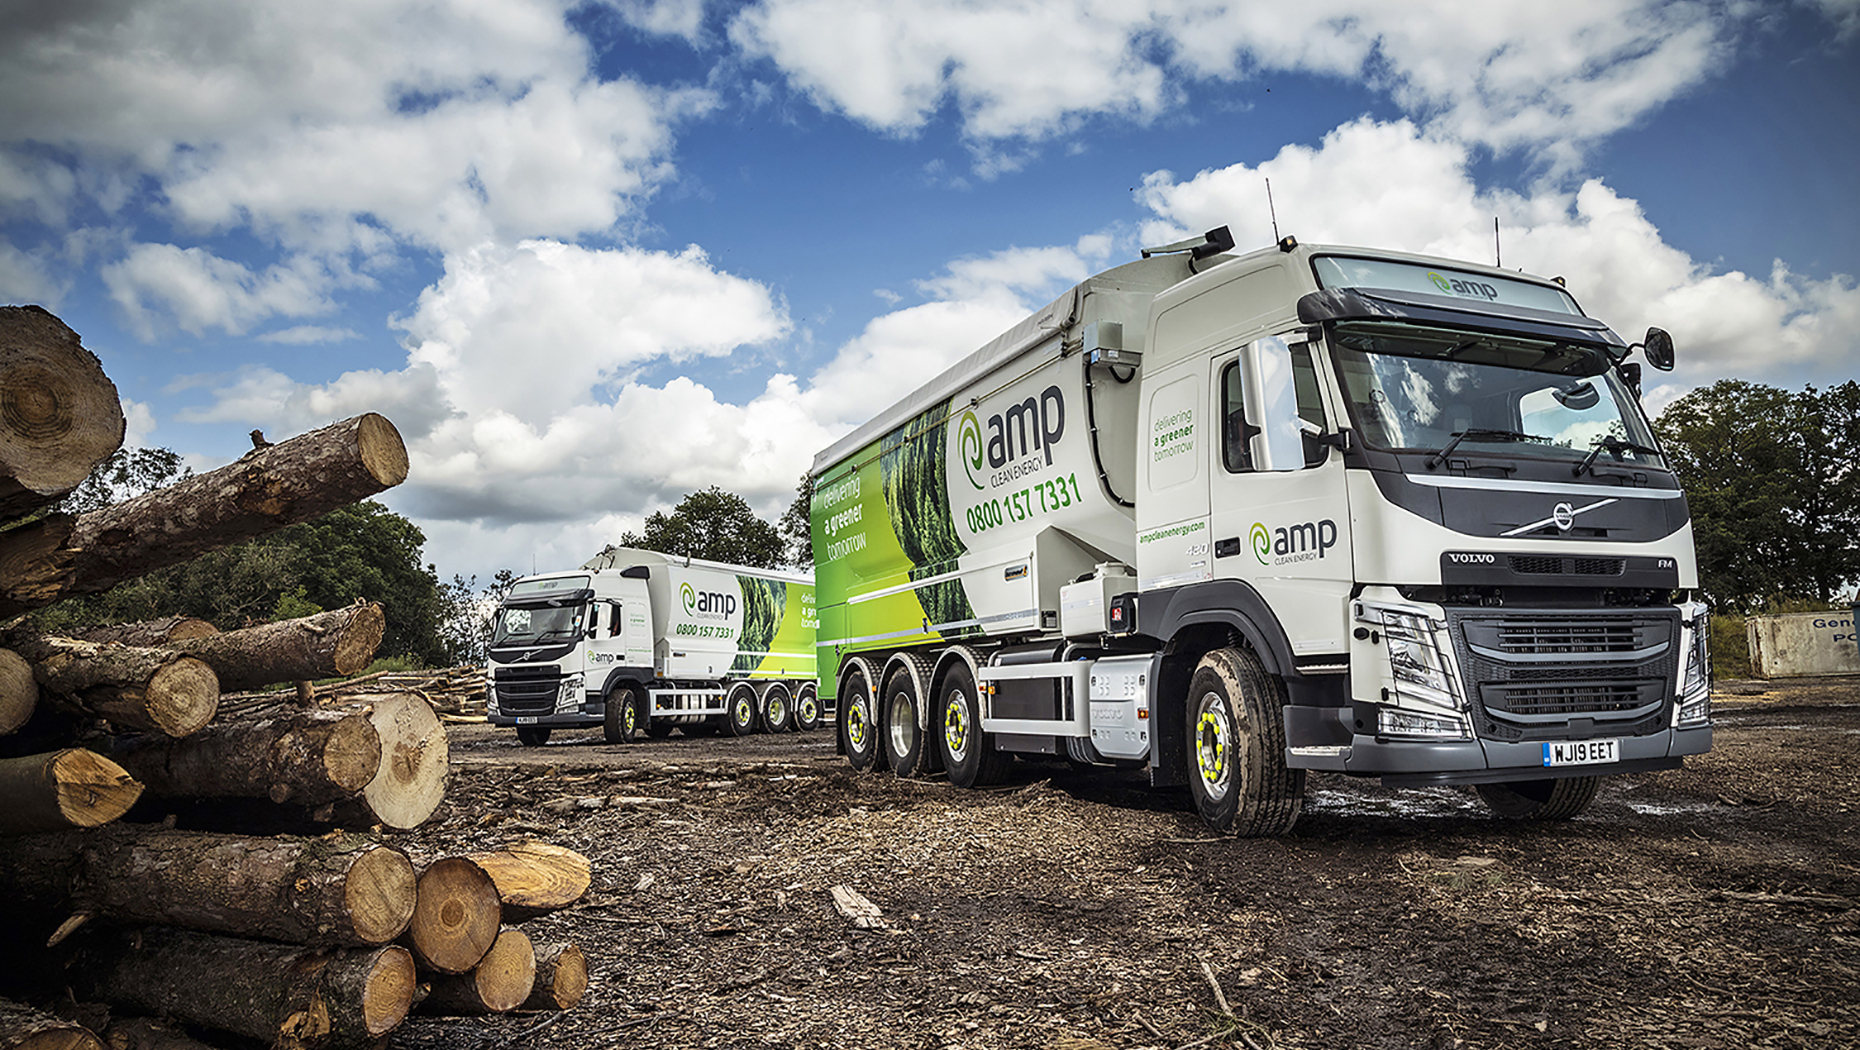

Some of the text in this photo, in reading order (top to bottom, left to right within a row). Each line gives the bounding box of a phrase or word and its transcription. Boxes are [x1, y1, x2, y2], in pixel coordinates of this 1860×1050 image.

[1450, 279, 1498, 301] amp
[987, 385, 1065, 469] amp
[1154, 410, 1192, 432] delivering
[1154, 424, 1194, 447] a greener
[1154, 441, 1194, 462] tomorrow
[990, 456, 1043, 488] CLEAN ENERGY
[824, 476, 860, 509] delivering
[966, 472, 1082, 534] 0800 157 7331
[824, 503, 862, 537] a greener
[1140, 522, 1205, 544] ampcleanenergy.com
[1274, 519, 1337, 559] amp
[827, 532, 867, 561] tomorrow
[1186, 543, 1209, 556] 420
[1274, 552, 1317, 566] CLEAN ENERGY
[1448, 553, 1495, 563] VOLVO
[1658, 559, 1672, 568] FM
[697, 591, 736, 620] amp
[676, 623, 734, 639] 0800 157 7331
[1812, 618, 1855, 629] Gen
[595, 653, 614, 664] amp
[1092, 709, 1123, 720] VOLVO
[1555, 741, 1614, 762] WJ19 EET
